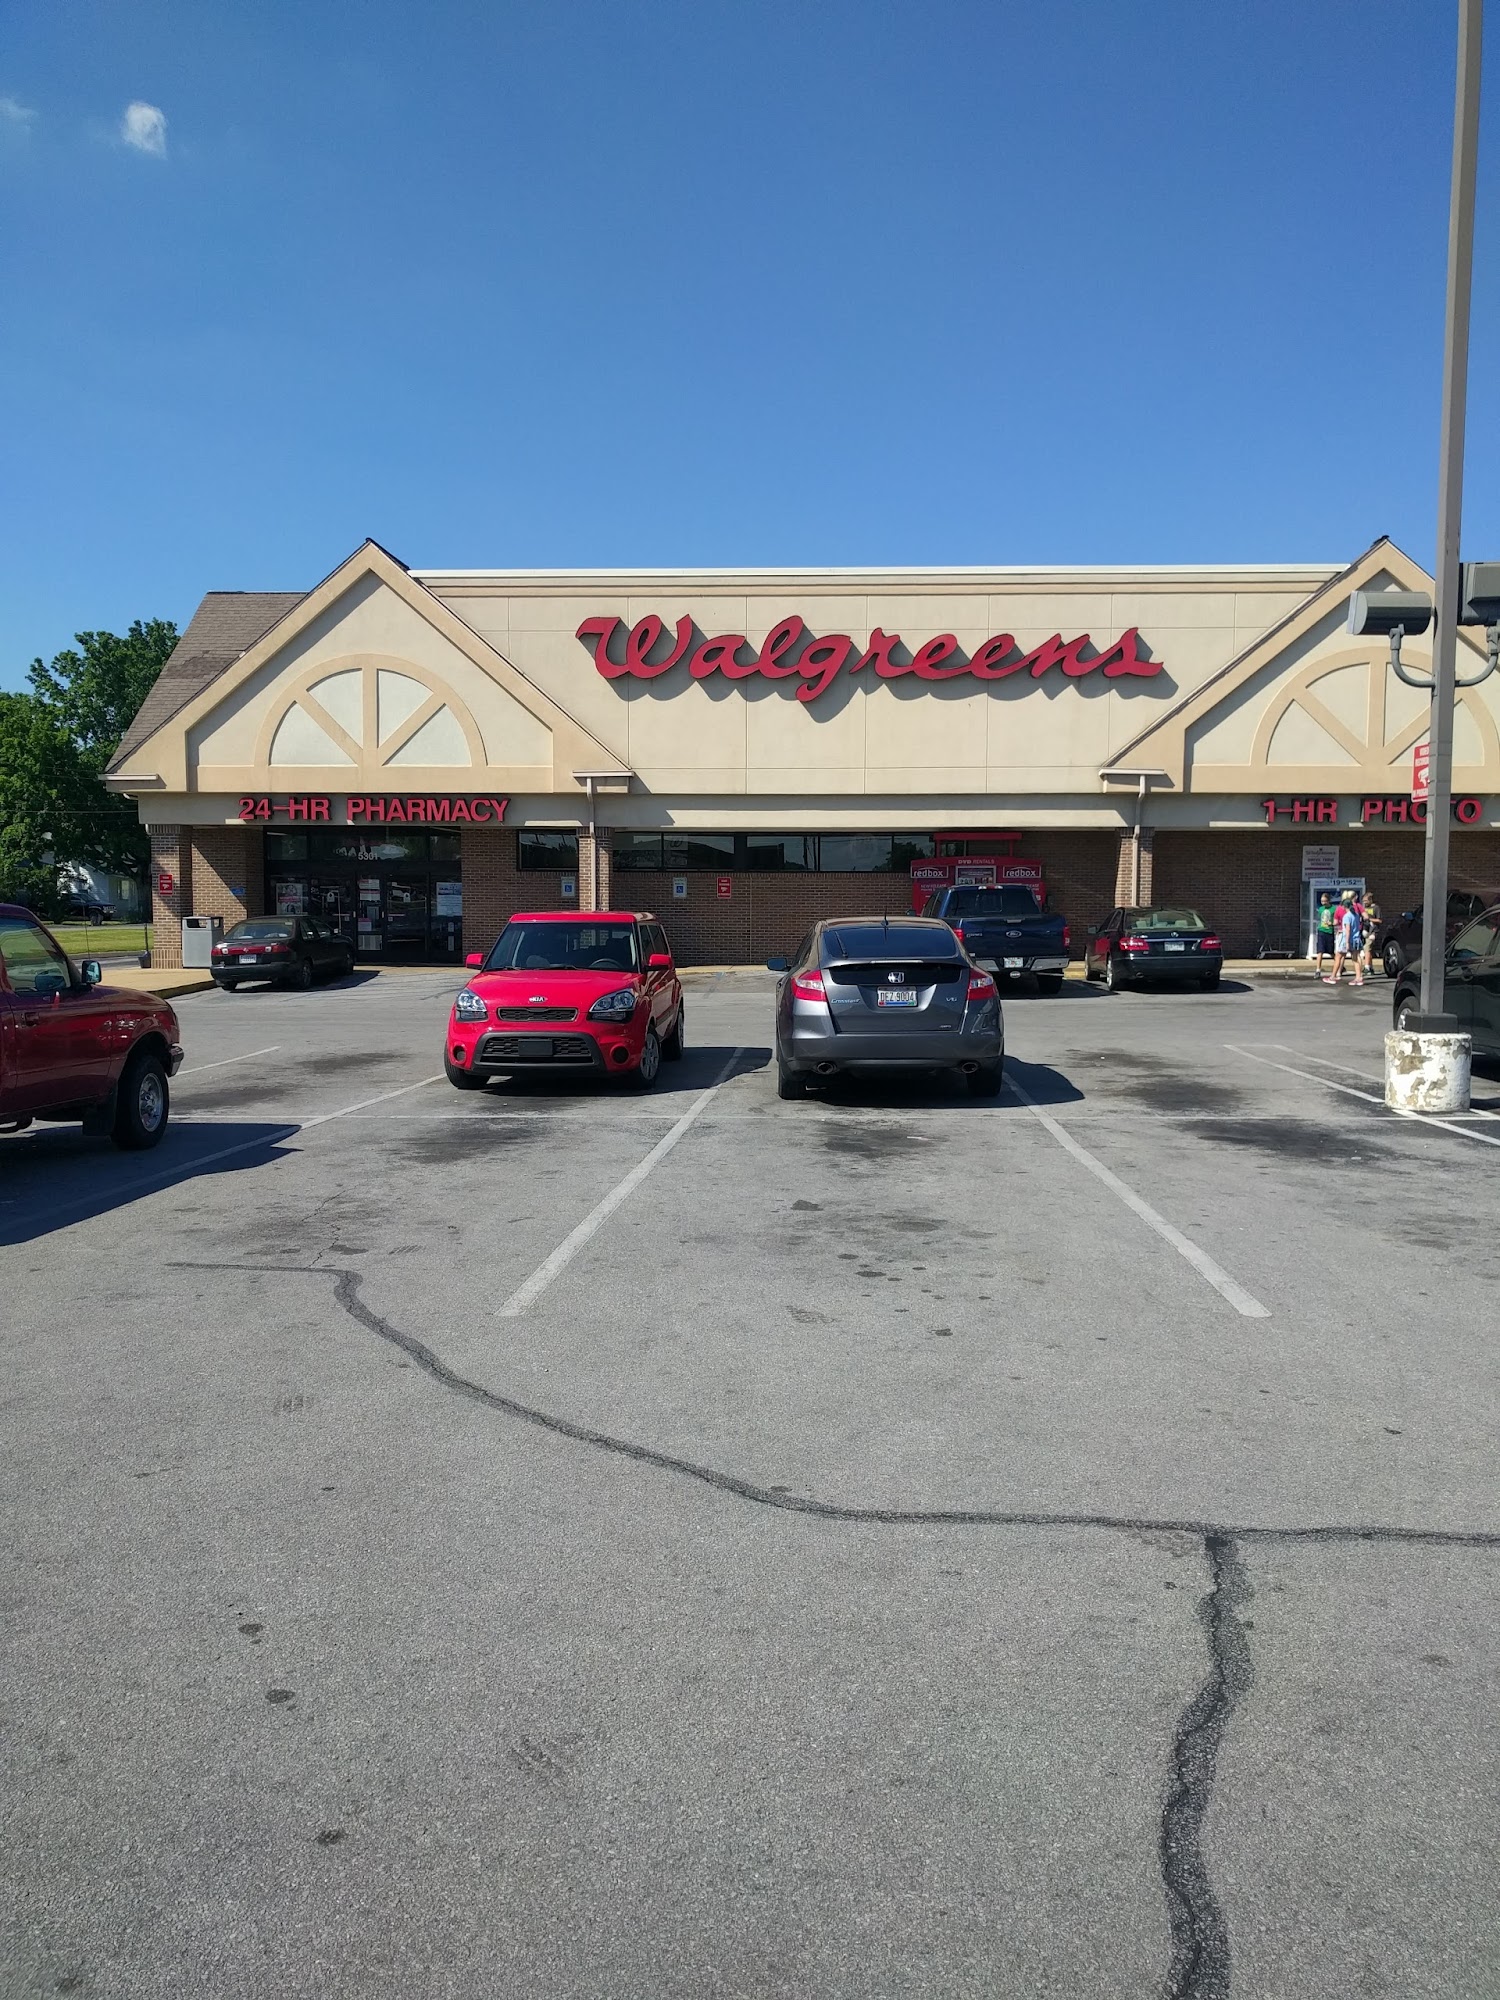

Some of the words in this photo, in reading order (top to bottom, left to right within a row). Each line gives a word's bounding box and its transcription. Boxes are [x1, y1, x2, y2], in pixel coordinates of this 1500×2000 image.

[575, 613, 1164, 702] Walgreens
[238, 797, 332, 821] 24-HR
[347, 797, 511, 823] PHARMACY
[1263, 798, 1339, 823] 1-HR
[1361, 797, 1483, 824] PHOO
[357, 851, 378, 861] 5301
[913, 868, 944, 877] redbox
[1006, 868, 1036, 877] redbox
